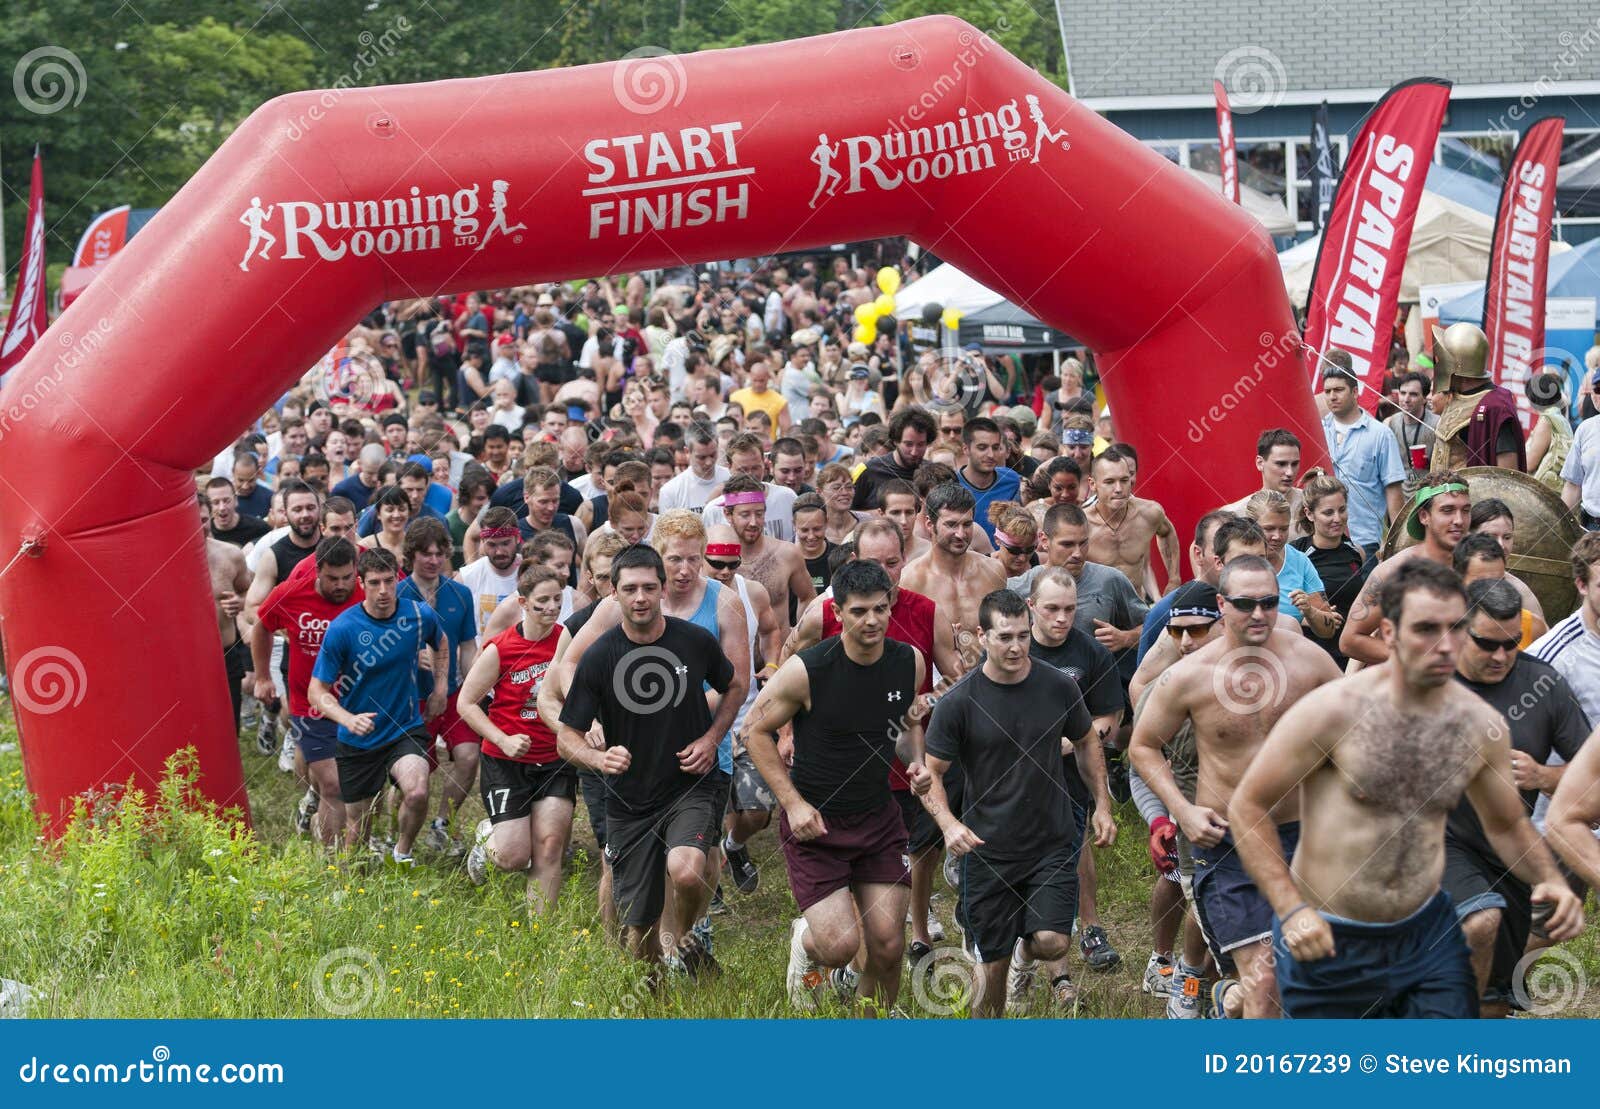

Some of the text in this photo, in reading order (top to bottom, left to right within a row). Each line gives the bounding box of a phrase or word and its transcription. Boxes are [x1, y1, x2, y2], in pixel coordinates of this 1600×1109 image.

[583, 121, 743, 184] START
[841, 99, 1028, 194] Running
[277, 183, 480, 262] Running
[588, 183, 749, 240] FINISH
[1504, 159, 1546, 330] SPARTAN
[487, 788, 511, 817] 17
